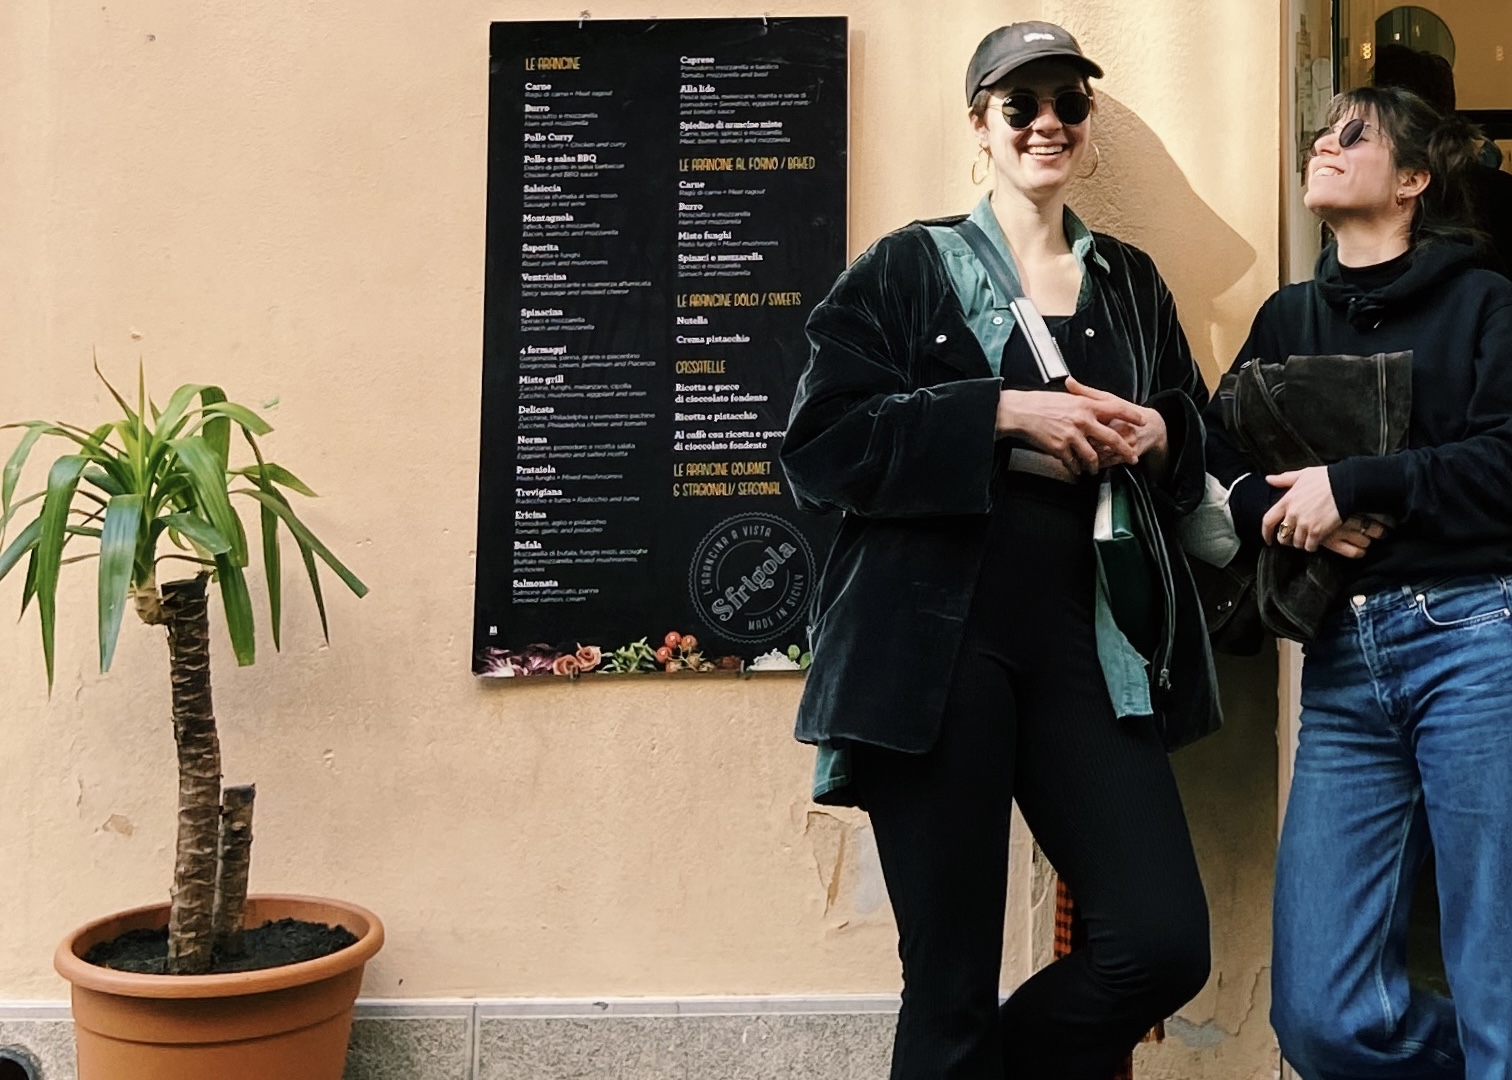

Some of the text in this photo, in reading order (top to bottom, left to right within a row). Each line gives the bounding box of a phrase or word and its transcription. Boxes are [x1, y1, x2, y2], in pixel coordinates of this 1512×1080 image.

[526, 57, 580, 70] LE ARANCINE
[680, 56, 714, 65] Caprese
[525, 104, 550, 112] Burro
[680, 121, 714, 131] Spiedino
[714, 120, 724, 129] di
[524, 133, 573, 142] Pollo Curry
[524, 155, 546, 163] Pollo
[554, 154, 576, 162] salsa
[577, 154, 596, 163] BBQ
[680, 159, 689, 171] LE
[692, 158, 733, 171] ARANCINE
[736, 157, 746, 170] AL
[749, 157, 778, 170] FORNO
[788, 156, 815, 169] BAKED
[524, 184, 561, 192] Salsiccia
[679, 202, 703, 210] Burro
[523, 213, 573, 223] Montagnola
[678, 231, 731, 240] Misto funghi
[522, 244, 559, 253] Saporita
[678, 254, 709, 263] Spinaci
[718, 252, 763, 261] mozzarella
[522, 273, 566, 281] Ventricina
[677, 294, 687, 307] LE
[689, 294, 731, 306] ARANCINE
[734, 293, 758, 306] DOLCI
[769, 292, 801, 305] SWEETS
[521, 309, 563, 318] Spinacina
[677, 316, 708, 324] Nutella
[706, 334, 750, 344] pistacchio
[528, 345, 566, 355] formaggi
[676, 360, 725, 374] CASSATELLE
[519, 375, 563, 385] Misto grill
[675, 393, 768, 403] di cioccolato fondente
[518, 405, 554, 414] Delicata
[675, 413, 706, 421] Ricotta
[714, 411, 757, 422] pistacchio
[674, 431, 684, 439] Al
[518, 436, 547, 444] Norma
[674, 441, 767, 450] di cioccolato fondente
[516, 465, 555, 474] Prataiola
[674, 462, 771, 476] LE ARANCINE GOURMET
[516, 488, 562, 497] Trevigiana
[673, 484, 680, 497] &
[738, 482, 781, 495] SEASONAL
[515, 511, 546, 519] Ericina
[514, 541, 542, 549] Bufala
[702, 526, 772, 596] L'ARANCINA A VISTA
[513, 579, 558, 587] Salmonata
[712, 542, 797, 622] Sfrigola
[748, 574, 804, 631] MADE IN SICILY
